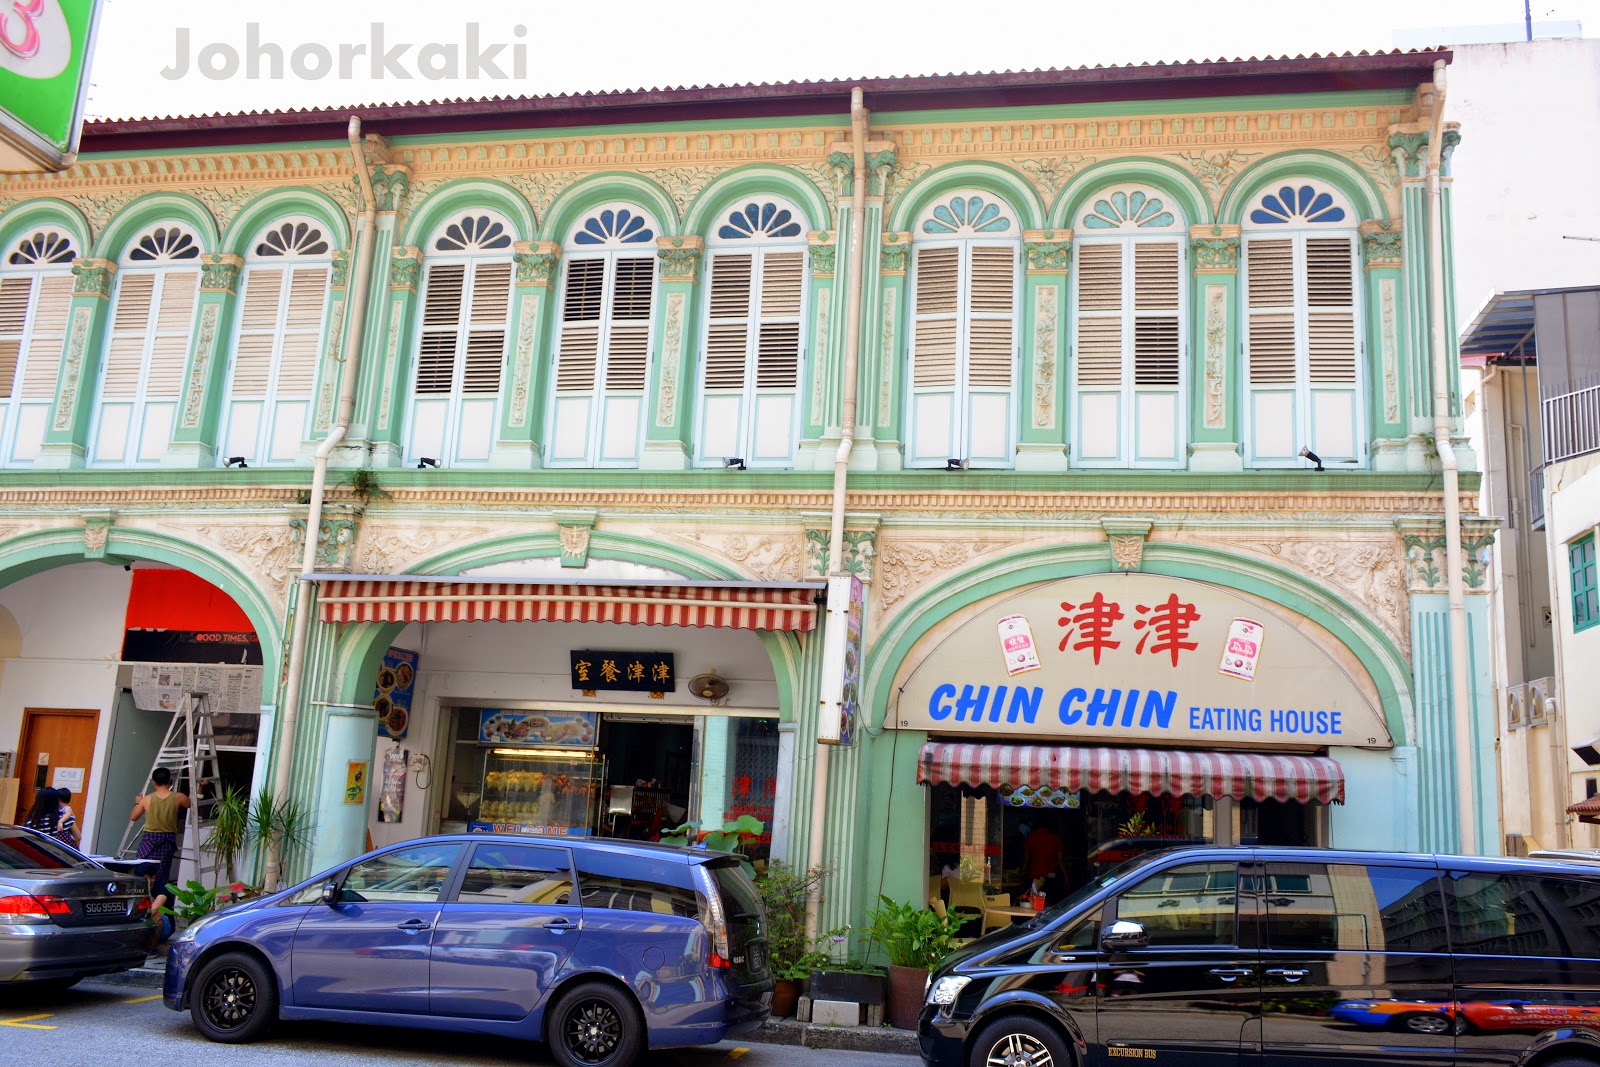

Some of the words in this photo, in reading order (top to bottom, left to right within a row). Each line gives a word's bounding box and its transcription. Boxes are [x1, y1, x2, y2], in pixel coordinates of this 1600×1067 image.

[1058, 592, 1201, 667] 津津
[196, 633, 221, 642] GOOD
[928, 683, 1044, 724] CHIN
[1058, 687, 1178, 728] CHIN
[1189, 707, 1263, 732] EATING
[1270, 709, 1342, 735] HOUSE
[1366, 737, 1377, 745] 19
[492, 823, 568, 836] WELCOME
[1108, 1046, 1143, 1058] EXCURSION
[1144, 1049, 1157, 1060] BUS
